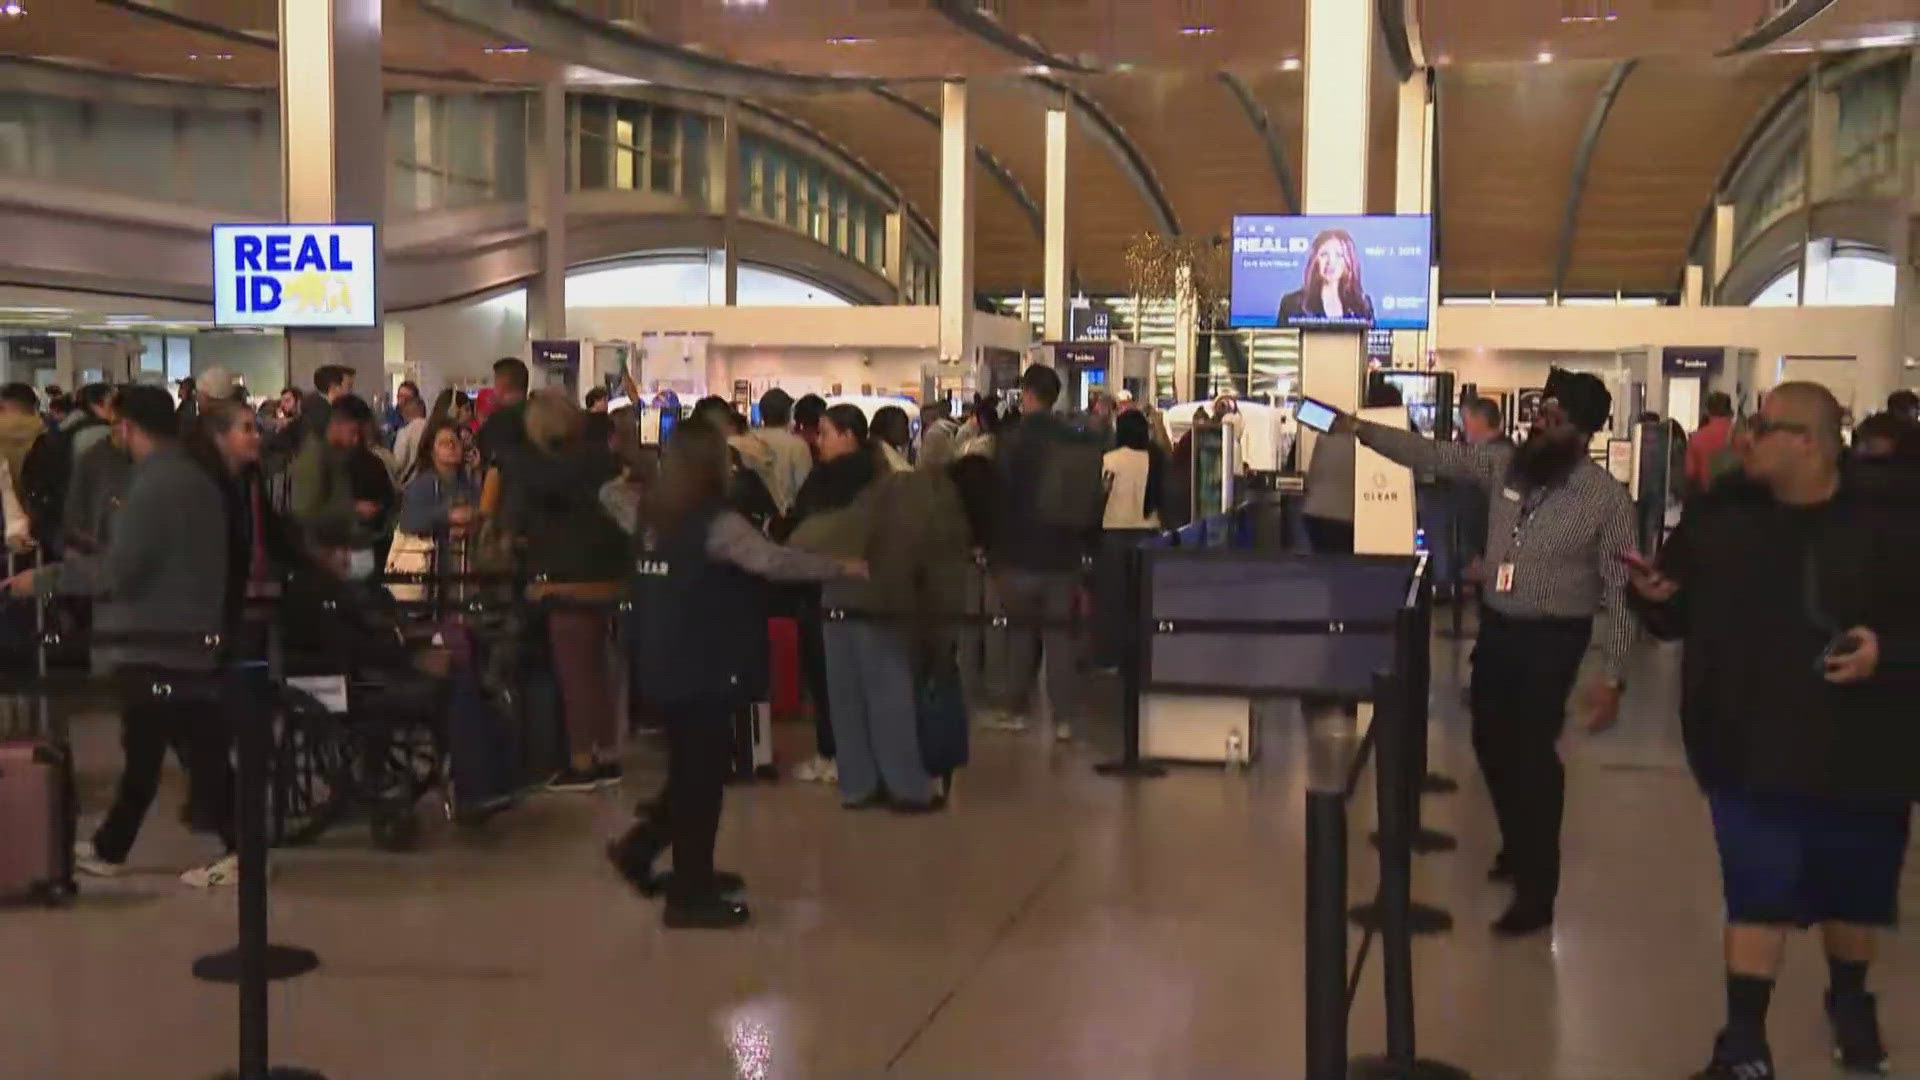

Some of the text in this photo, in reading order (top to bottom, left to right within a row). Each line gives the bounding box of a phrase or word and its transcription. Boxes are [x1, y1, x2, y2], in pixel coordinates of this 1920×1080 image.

[234, 234, 353, 271] REAL
[1233, 236, 1288, 253] REAL
[236, 275, 282, 312] ID
[1363, 491, 1398, 502] CLEAR
[637, 560, 669, 576] LEAR
